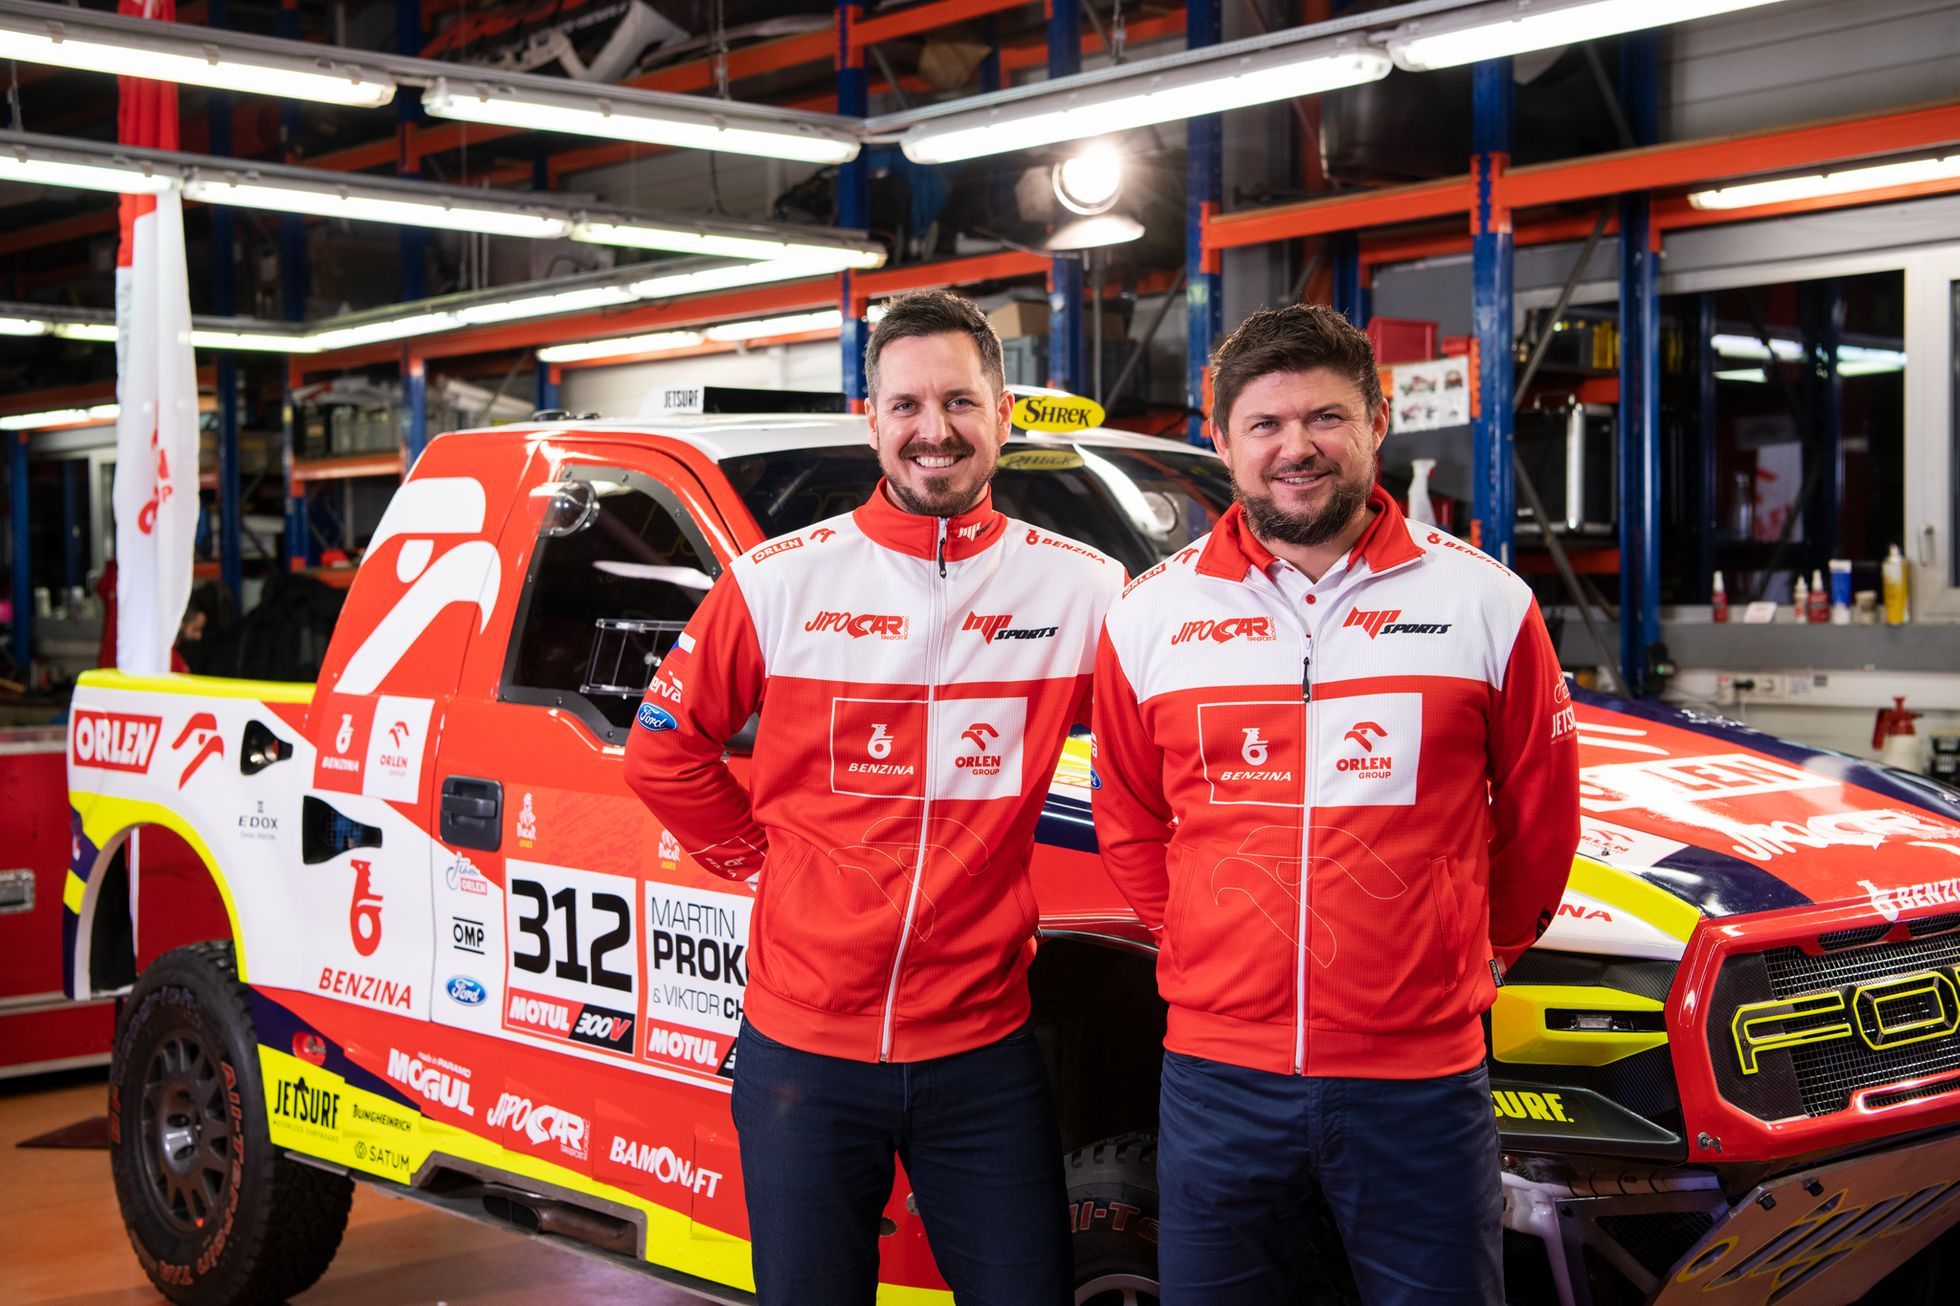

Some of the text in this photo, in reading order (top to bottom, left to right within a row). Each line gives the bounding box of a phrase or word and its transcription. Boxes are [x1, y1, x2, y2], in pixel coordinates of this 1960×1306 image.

[664, 390, 699, 408] JETSURF
[755, 539, 800, 560] ORLEN
[1042, 538, 1106, 564] BENZINA
[994, 626, 1059, 641] SPORTS
[1380, 624, 1452, 635] SPORTS
[640, 704, 667, 728] Ford
[75, 716, 157, 766] ORLEN
[380, 754, 408, 769] ORLEN
[848, 762, 915, 776] BENZINA
[955, 755, 1002, 769] ORLEN
[972, 768, 1001, 776] GROUP
[1336, 757, 1392, 772] ORLEN
[1220, 771, 1292, 782] BENZINA
[1358, 771, 1392, 780] GROUP
[238, 815, 279, 830] EDOX
[652, 896, 735, 939] MARTIN
[453, 923, 484, 948] OMP
[511, 878, 633, 993] 312
[653, 929, 749, 987] PROK
[318, 967, 412, 1010] BENZINA
[451, 979, 482, 1003] Ford
[653, 988, 661, 1003] &
[664, 984, 720, 1016] VIKTOR
[508, 995, 632, 1042] MOTUL 300V
[648, 1027, 719, 1067] MOTUL
[387, 1047, 475, 1117] MOGUL
[274, 1076, 340, 1130] JETSURF
[369, 1145, 410, 1172] SATUM
